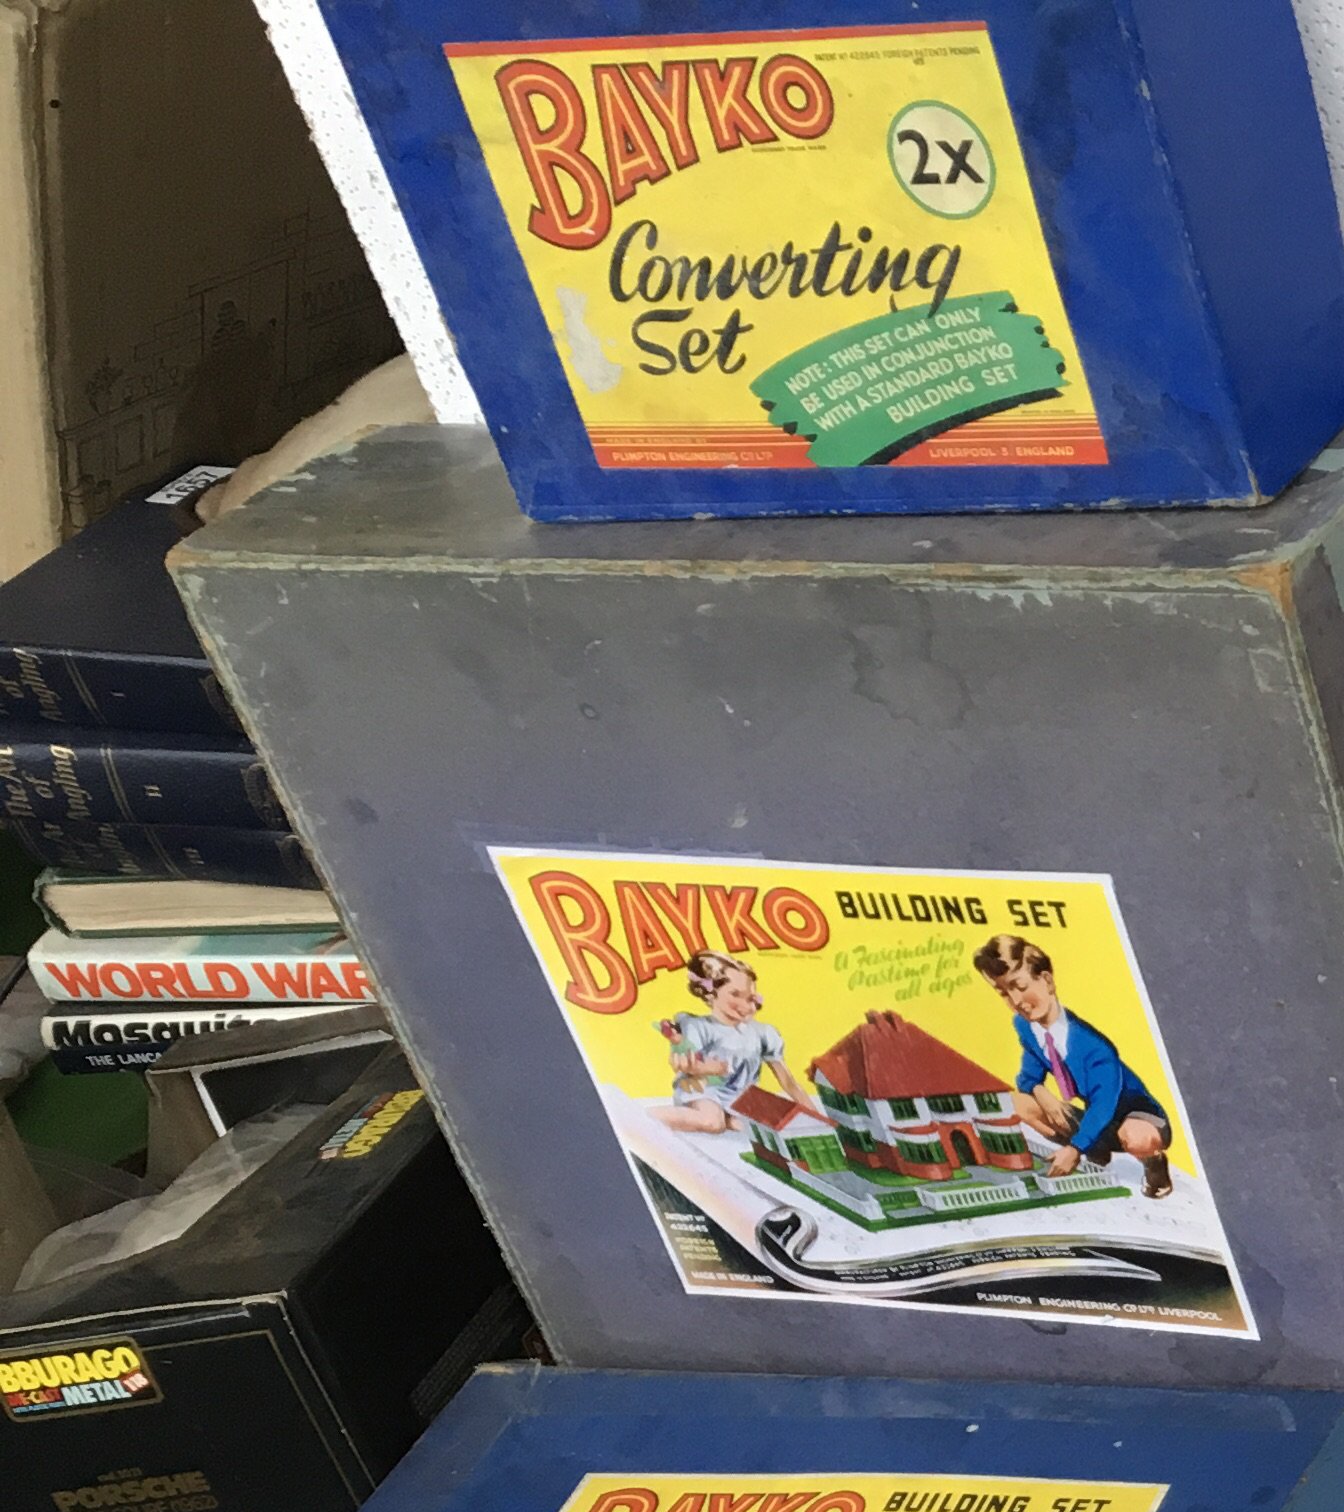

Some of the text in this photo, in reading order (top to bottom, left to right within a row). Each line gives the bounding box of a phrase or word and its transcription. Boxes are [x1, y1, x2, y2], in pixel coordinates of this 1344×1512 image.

[494, 53, 833, 250] BAYKO
[609, 220, 962, 316] Converting
[631, 308, 754, 377] Set
[50, 745, 92, 820] Angling
[529, 871, 1067, 1015] BAYKO BUILDING SET
[44, 962, 376, 999] WORLD WAR
[86, 1054, 114, 1067] THE
[0, 1347, 140, 1393] BBURAGO
[61, 1380, 132, 1406] METAL
[51, 1471, 210, 1512] PORSCHE
